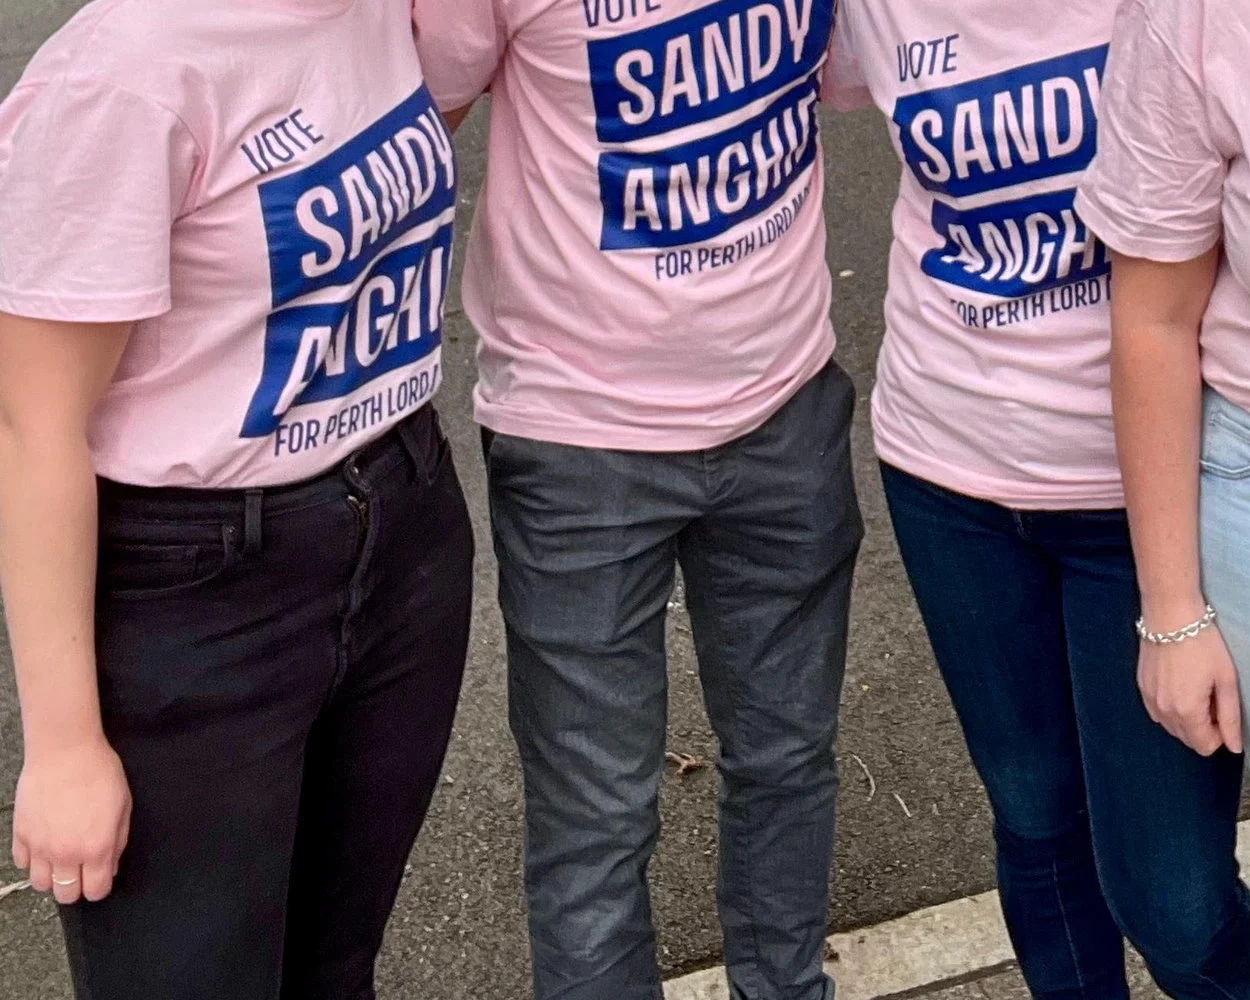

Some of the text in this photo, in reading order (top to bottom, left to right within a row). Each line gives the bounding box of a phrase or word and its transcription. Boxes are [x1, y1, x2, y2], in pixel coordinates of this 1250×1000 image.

[896, 33, 959, 82] VOTE
[241, 108, 323, 175] VOTE
[295, 106, 455, 279] SANDY
[655, 250, 692, 280] FOR
[697, 233, 756, 272] PERTH
[273, 246, 452, 416] ANGHI
[951, 299, 979, 327] OR
[982, 293, 1045, 329] PERTH
[1051, 279, 1100, 313] LORD
[274, 419, 320, 457] FOR
[324, 392, 382, 444] PERTH
[387, 370, 429, 417] LORD
